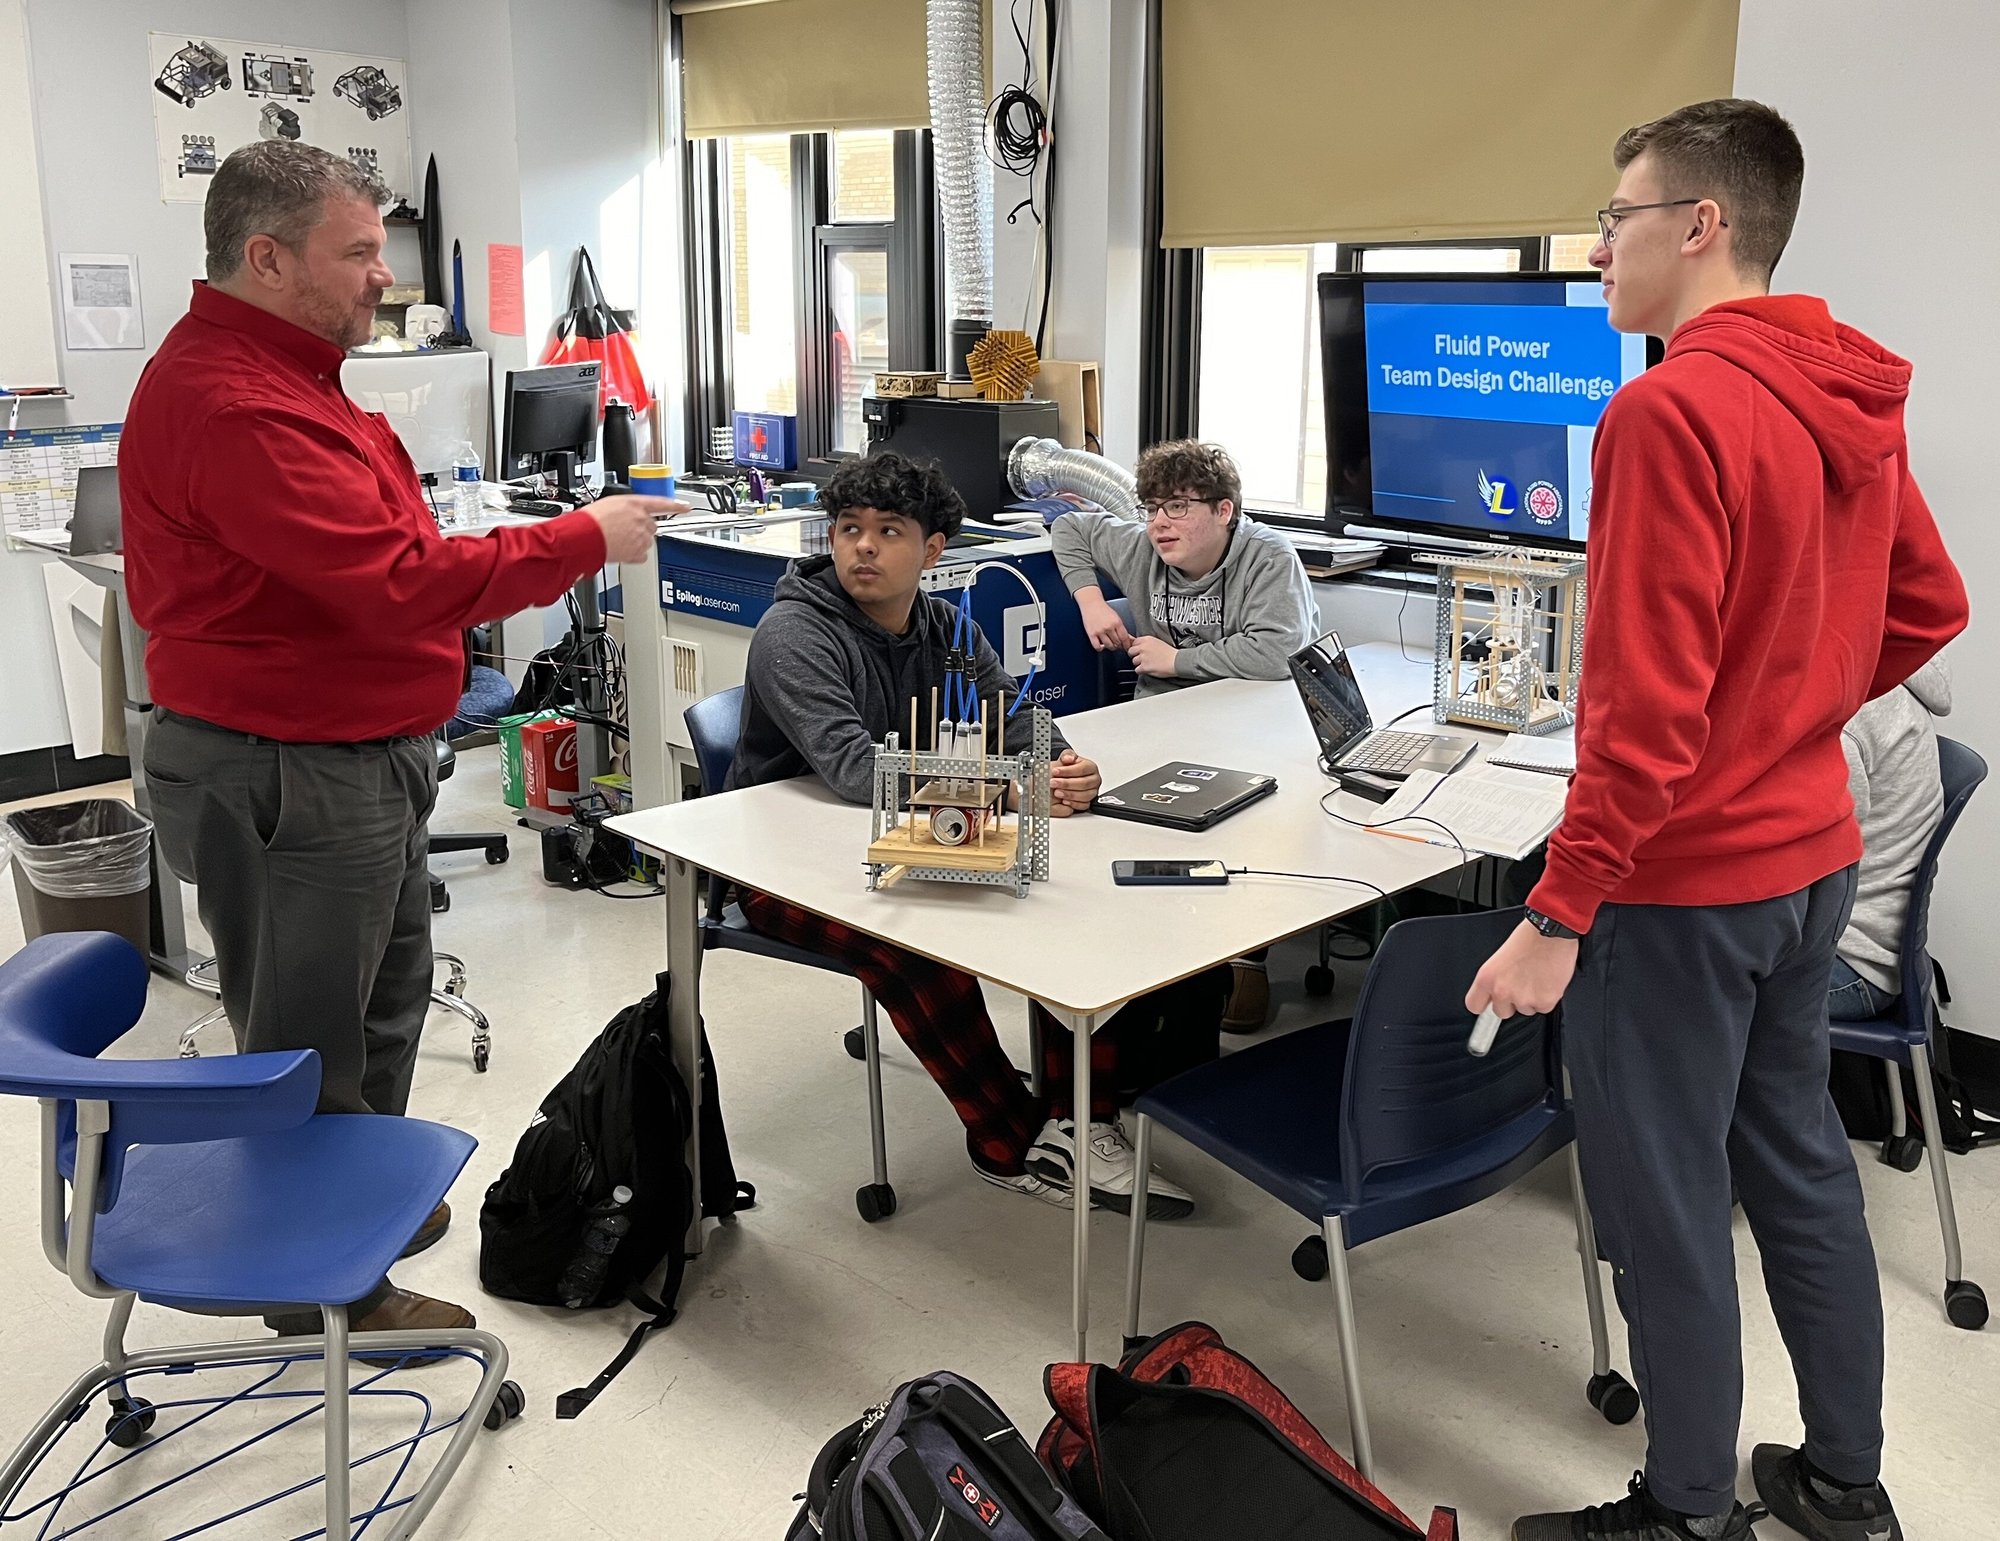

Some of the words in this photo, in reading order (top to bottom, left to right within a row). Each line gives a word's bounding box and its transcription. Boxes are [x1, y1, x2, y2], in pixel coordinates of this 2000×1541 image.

[1434, 333, 1481, 356] Fluid
[1487, 335, 1550, 359] Power
[579, 366, 598, 377] acer
[1381, 364, 1432, 387] Team
[1438, 367, 1503, 395] Design
[1509, 370, 1614, 401] Challenge
[1489, 481, 1515, 515] L
[676, 589, 740, 613] EpilogLaser.com
[1149, 592, 1223, 626] RTHWESTER
[500, 735, 512, 791] Sprite
